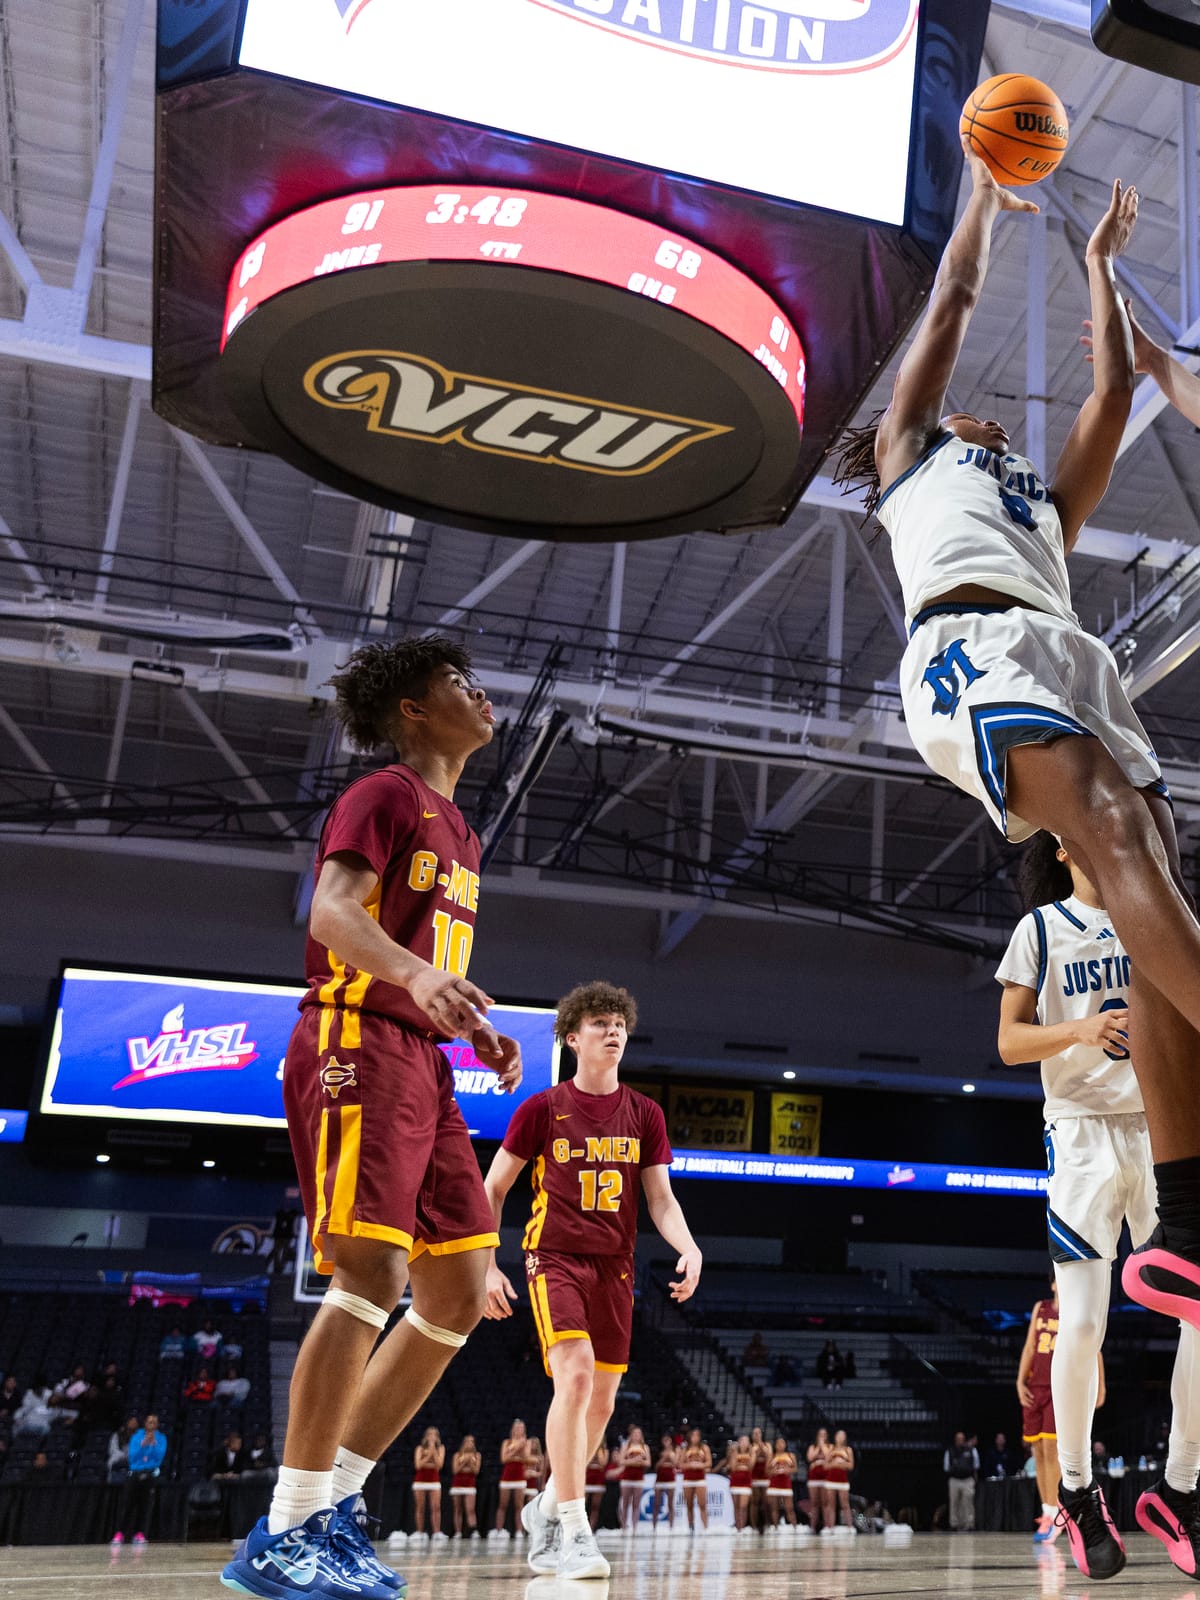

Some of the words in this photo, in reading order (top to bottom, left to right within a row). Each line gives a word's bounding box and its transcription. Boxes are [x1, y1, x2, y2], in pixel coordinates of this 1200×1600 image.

[573, 0, 826, 62] ATION
[341, 200, 384, 235] 91
[426, 194, 528, 227] 3:48
[654, 240, 701, 279] 68
[376, 358, 692, 468] VCU
[432, 909, 475, 980] 10
[128, 1022, 256, 1071] VHSL
[675, 1094, 746, 1118] NCAA
[552, 1136, 641, 1164] G-MEN
[701, 1128, 746, 1145] 2021
[777, 1134, 813, 1151] 2021
[685, 1157, 745, 1175] BASKETBALL
[745, 1160, 775, 1176] STATE
[774, 1163, 855, 1181] CHAMPIONSHIPS
[578, 1169, 623, 1212] 12
